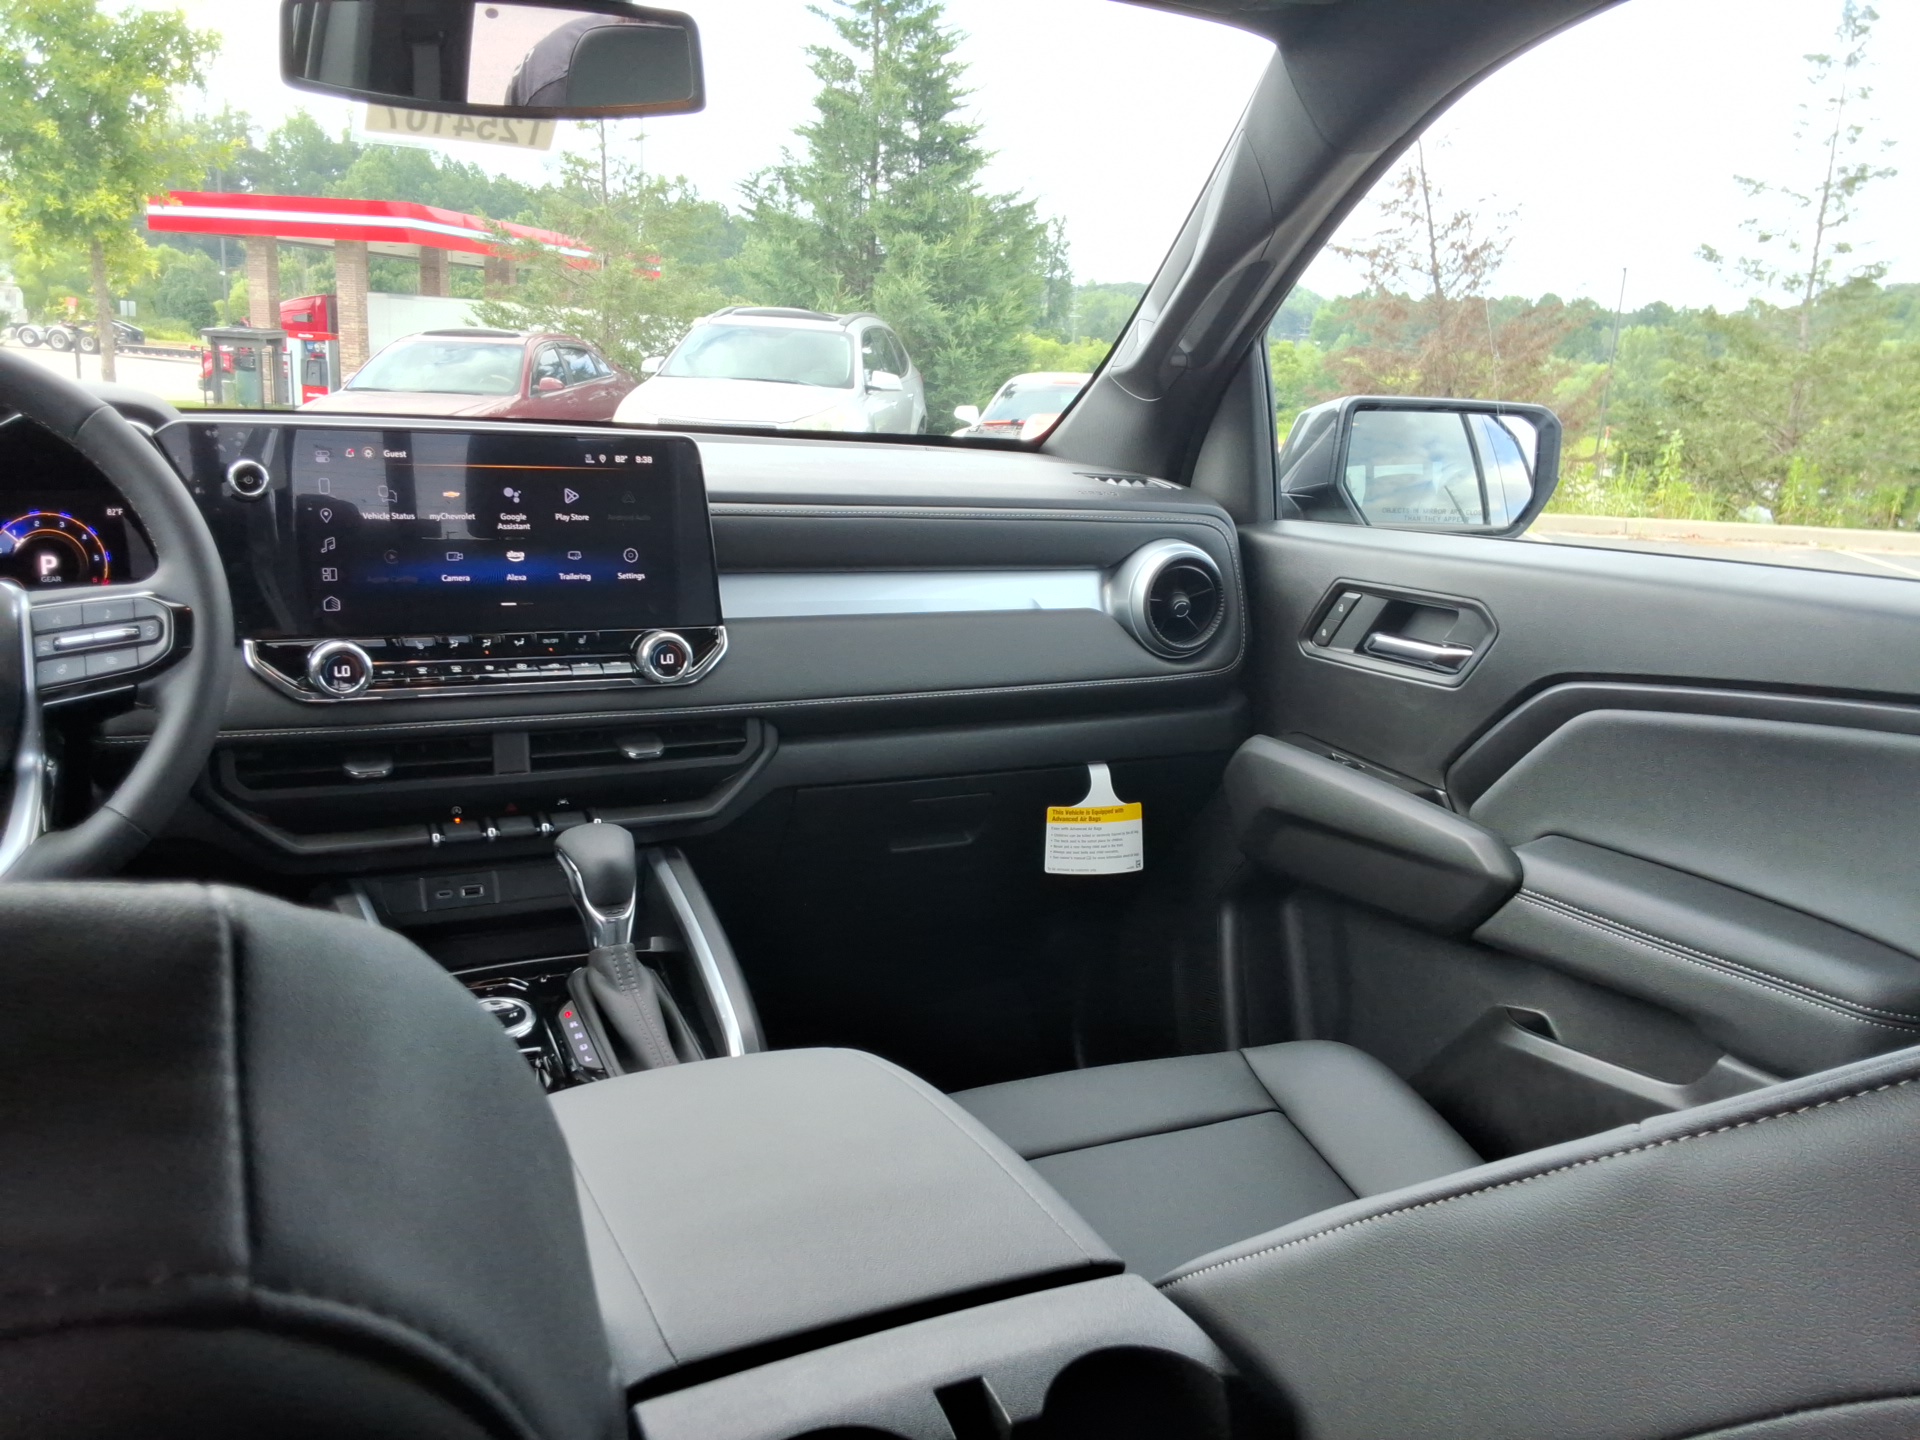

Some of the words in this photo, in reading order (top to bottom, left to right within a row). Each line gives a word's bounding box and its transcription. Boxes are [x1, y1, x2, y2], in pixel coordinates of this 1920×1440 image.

[383, 450, 407, 458] Guest
[1423, 507, 1447, 515] MIRROR
[362, 512, 390, 520] Vehicle
[391, 512, 415, 520] Status
[429, 512, 476, 521] myChevrolet
[500, 513, 527, 522] Google
[555, 513, 570, 522] Play
[571, 513, 590, 521] Store
[40, 554, 58, 575] P
[441, 574, 471, 582] Camera
[506, 573, 527, 581] Alexa
[558, 572, 592, 582] Trailering
[617, 572, 646, 581] Settings
[1092, 808, 1114, 816] Equipped
